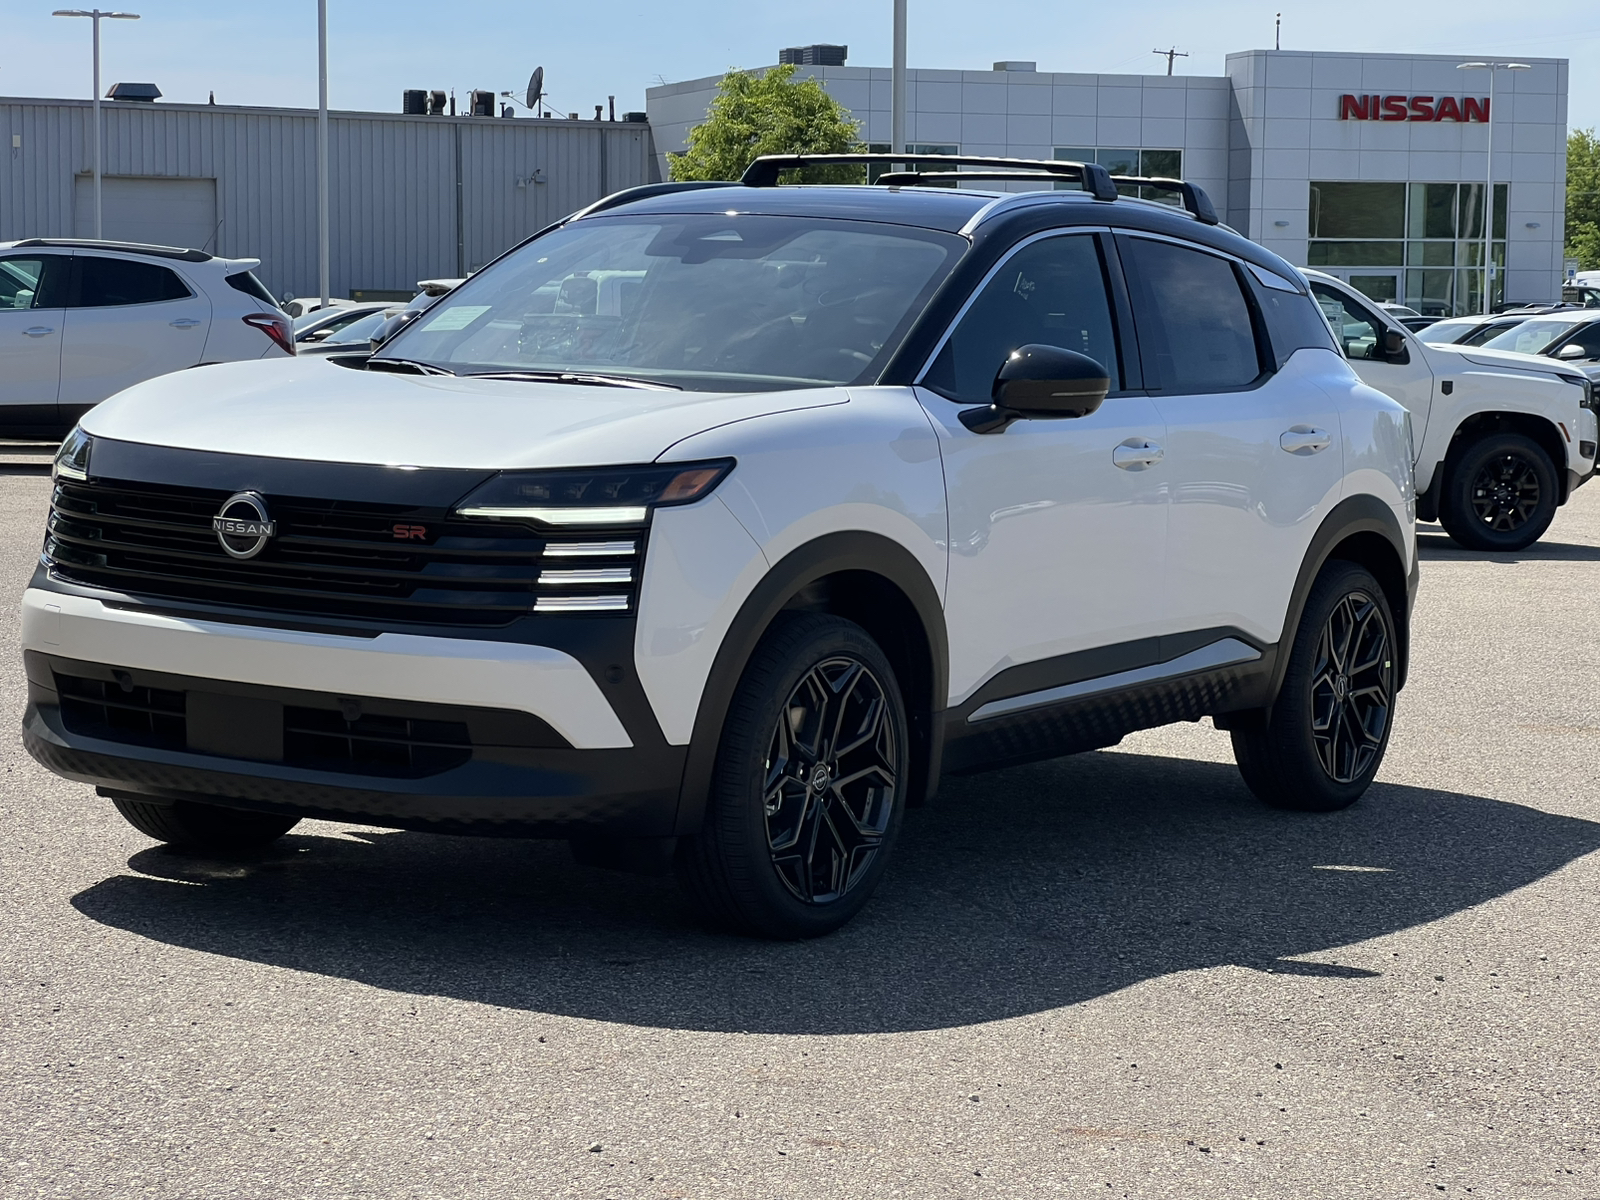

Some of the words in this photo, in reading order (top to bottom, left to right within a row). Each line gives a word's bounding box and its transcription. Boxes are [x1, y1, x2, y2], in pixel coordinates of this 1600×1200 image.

[1339, 93, 1491, 123] NISSAN
[213, 519, 271, 534] NISSAN
[392, 524, 426, 540] SR
